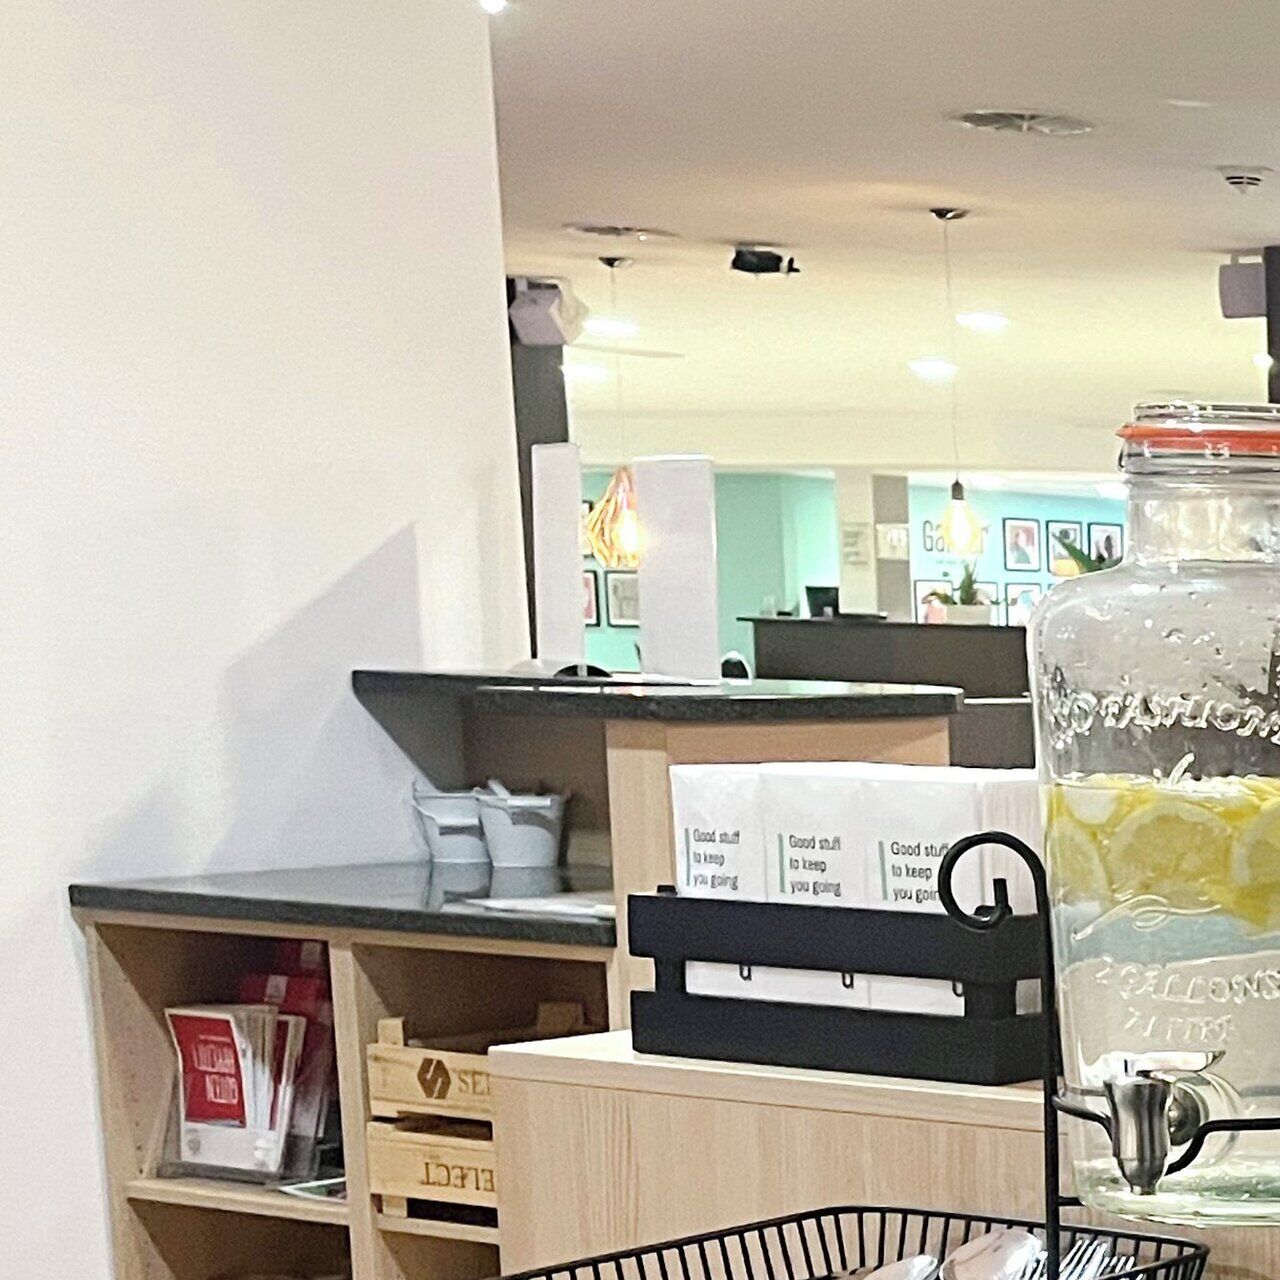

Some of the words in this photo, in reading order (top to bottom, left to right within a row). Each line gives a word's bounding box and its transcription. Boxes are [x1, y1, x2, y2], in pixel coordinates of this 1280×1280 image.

[922, 519, 990, 554] Gar
[693, 828, 716, 843] Good
[719, 830, 740, 844] stuff
[789, 835, 816, 850] Good
[819, 836, 841, 851] stuff
[890, 841, 921, 857] Good
[693, 851, 702, 863] to
[703, 851, 725, 867] keep
[789, 857, 799, 870] to
[802, 857, 827, 873] keep
[891, 863, 903, 877] to
[905, 863, 933, 882] keep
[693, 874, 708, 887] you
[710, 873, 739, 891] going
[790, 880, 810, 893] you
[812, 880, 841, 897] going
[893, 887, 913, 902] you
[915, 886, 941, 904] goin
[420, 1162, 495, 1192] ELECT
